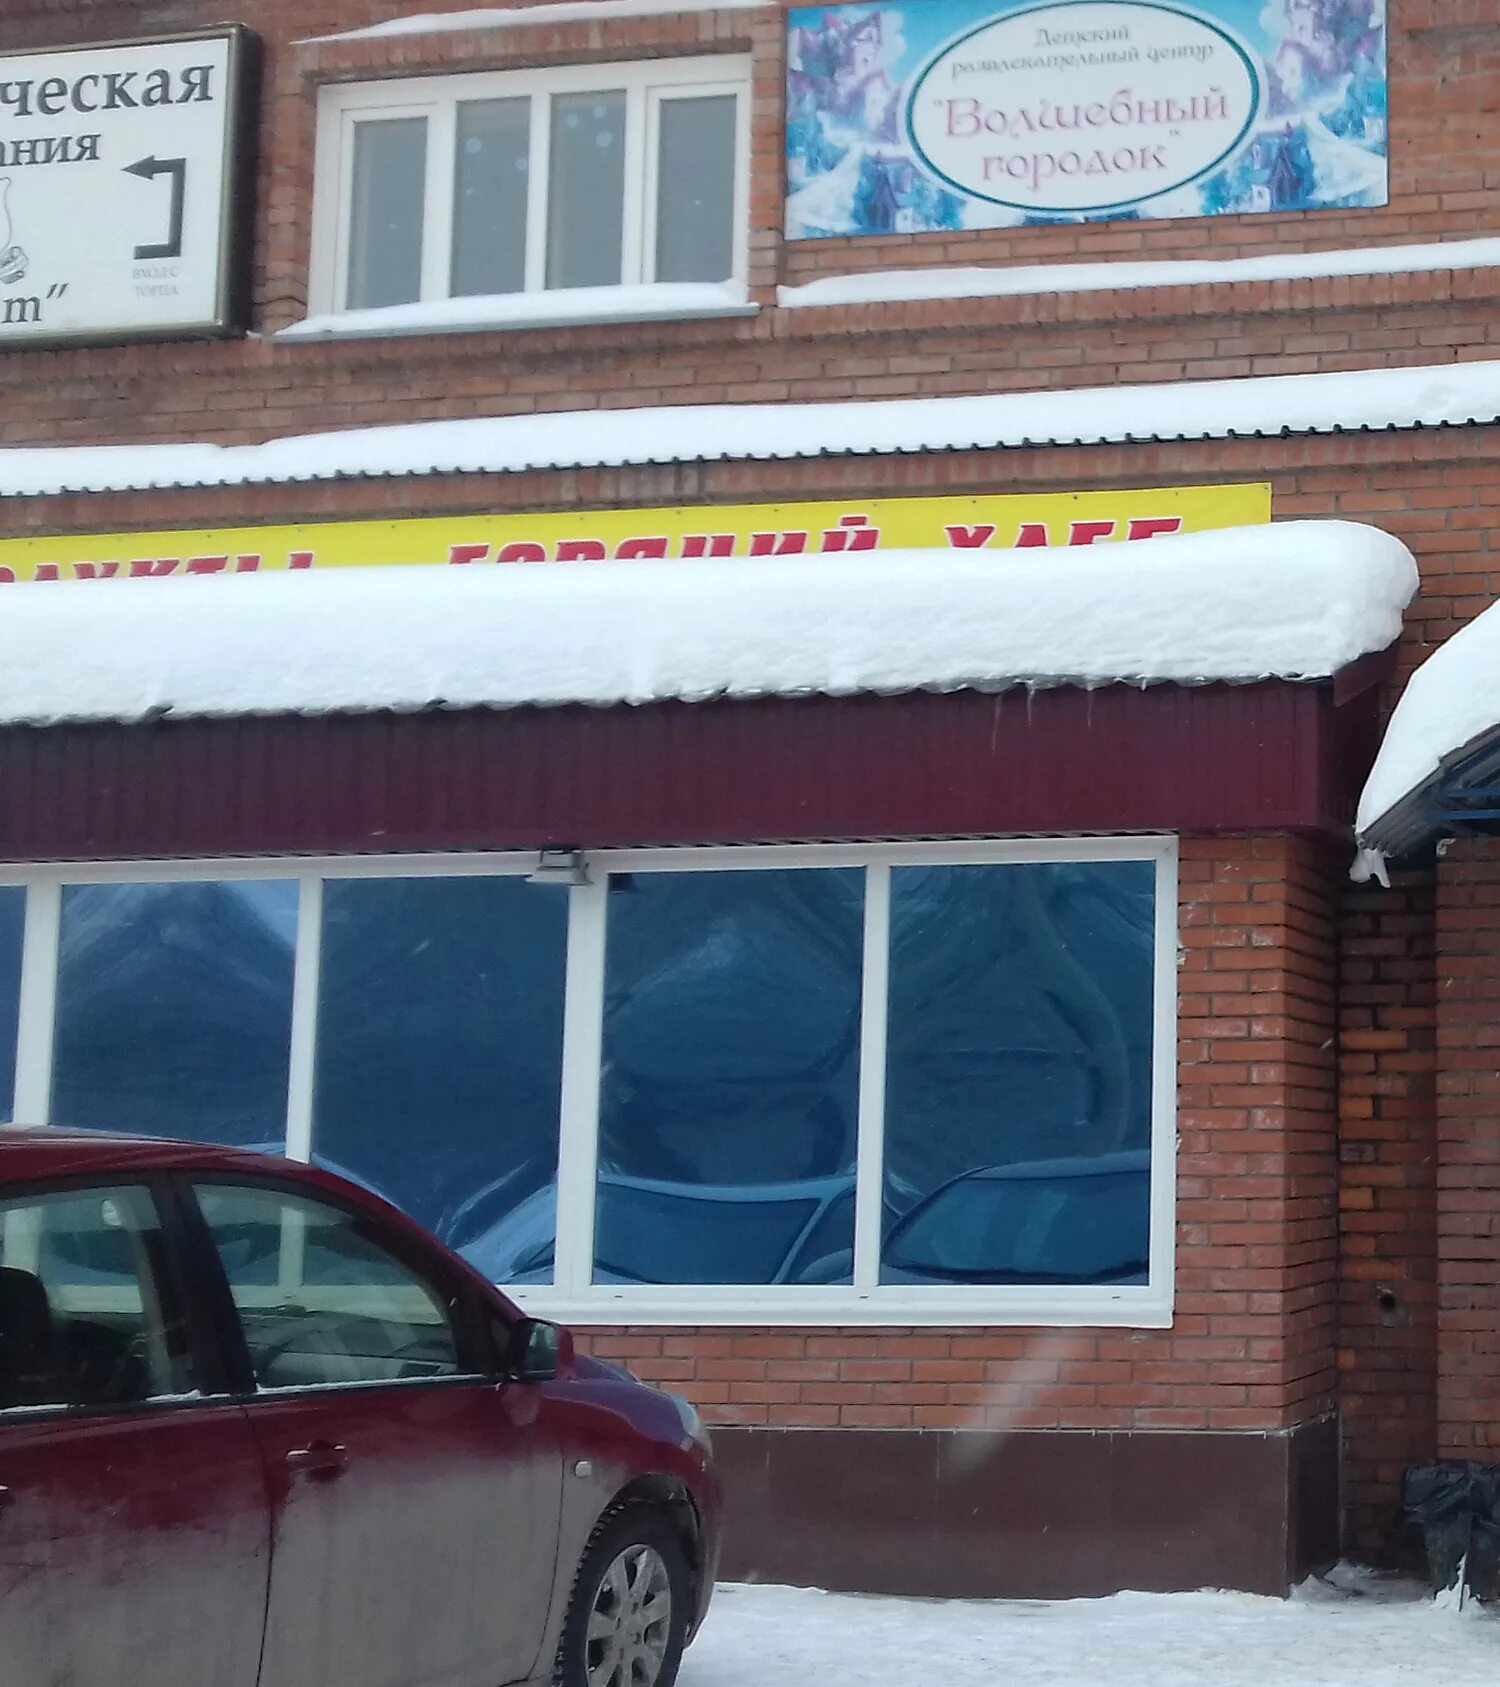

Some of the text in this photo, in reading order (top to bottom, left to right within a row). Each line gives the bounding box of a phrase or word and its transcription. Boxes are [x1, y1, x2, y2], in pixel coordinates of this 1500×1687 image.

[1034, 25, 1130, 47] Детский
[952, 43, 1214, 79] развлекательный центр
